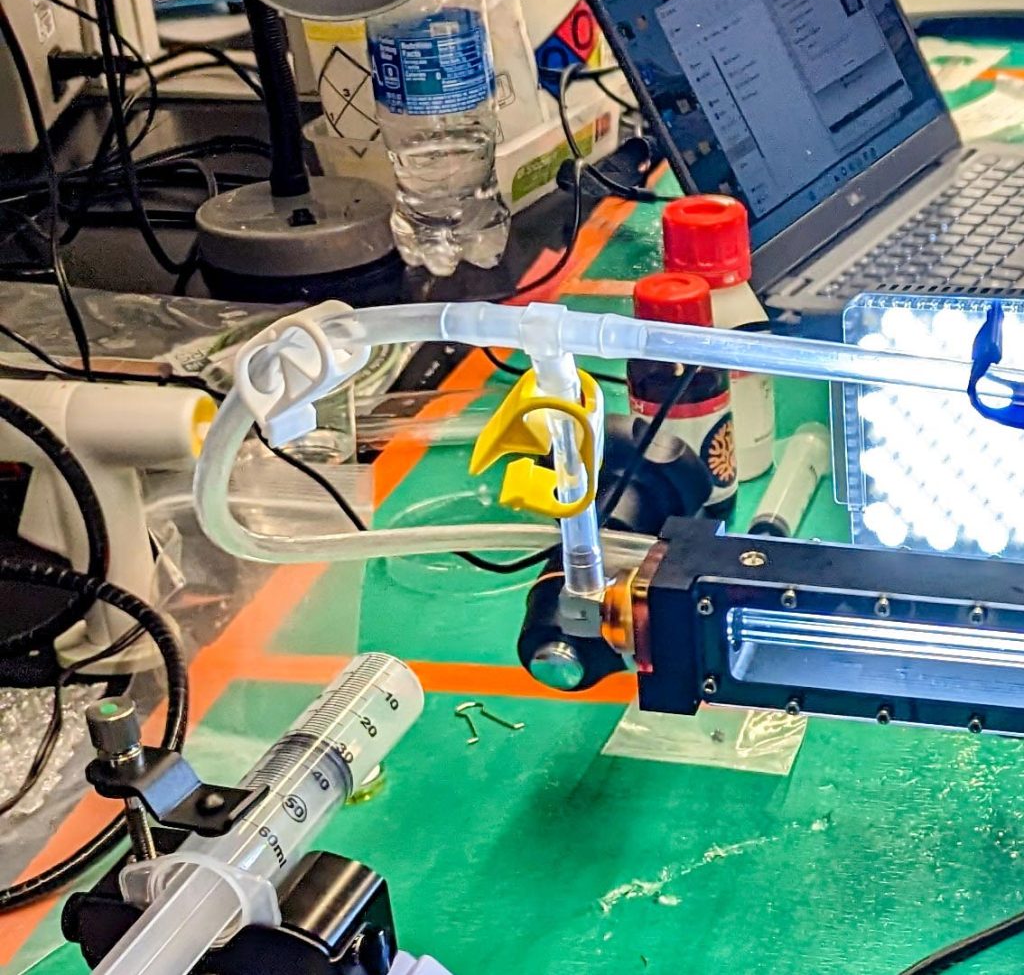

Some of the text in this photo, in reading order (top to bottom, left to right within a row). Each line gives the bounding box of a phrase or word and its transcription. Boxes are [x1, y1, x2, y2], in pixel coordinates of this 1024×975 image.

[572, 9, 593, 50] 0
[342, 88, 351, 97] 3
[383, 692, 400, 711] 10
[360, 716, 378, 738] 20
[337, 742, 354, 764] 30
[312, 770, 330, 791] 40
[284, 796, 305, 819] 50
[258, 826, 288, 869] 60ml
